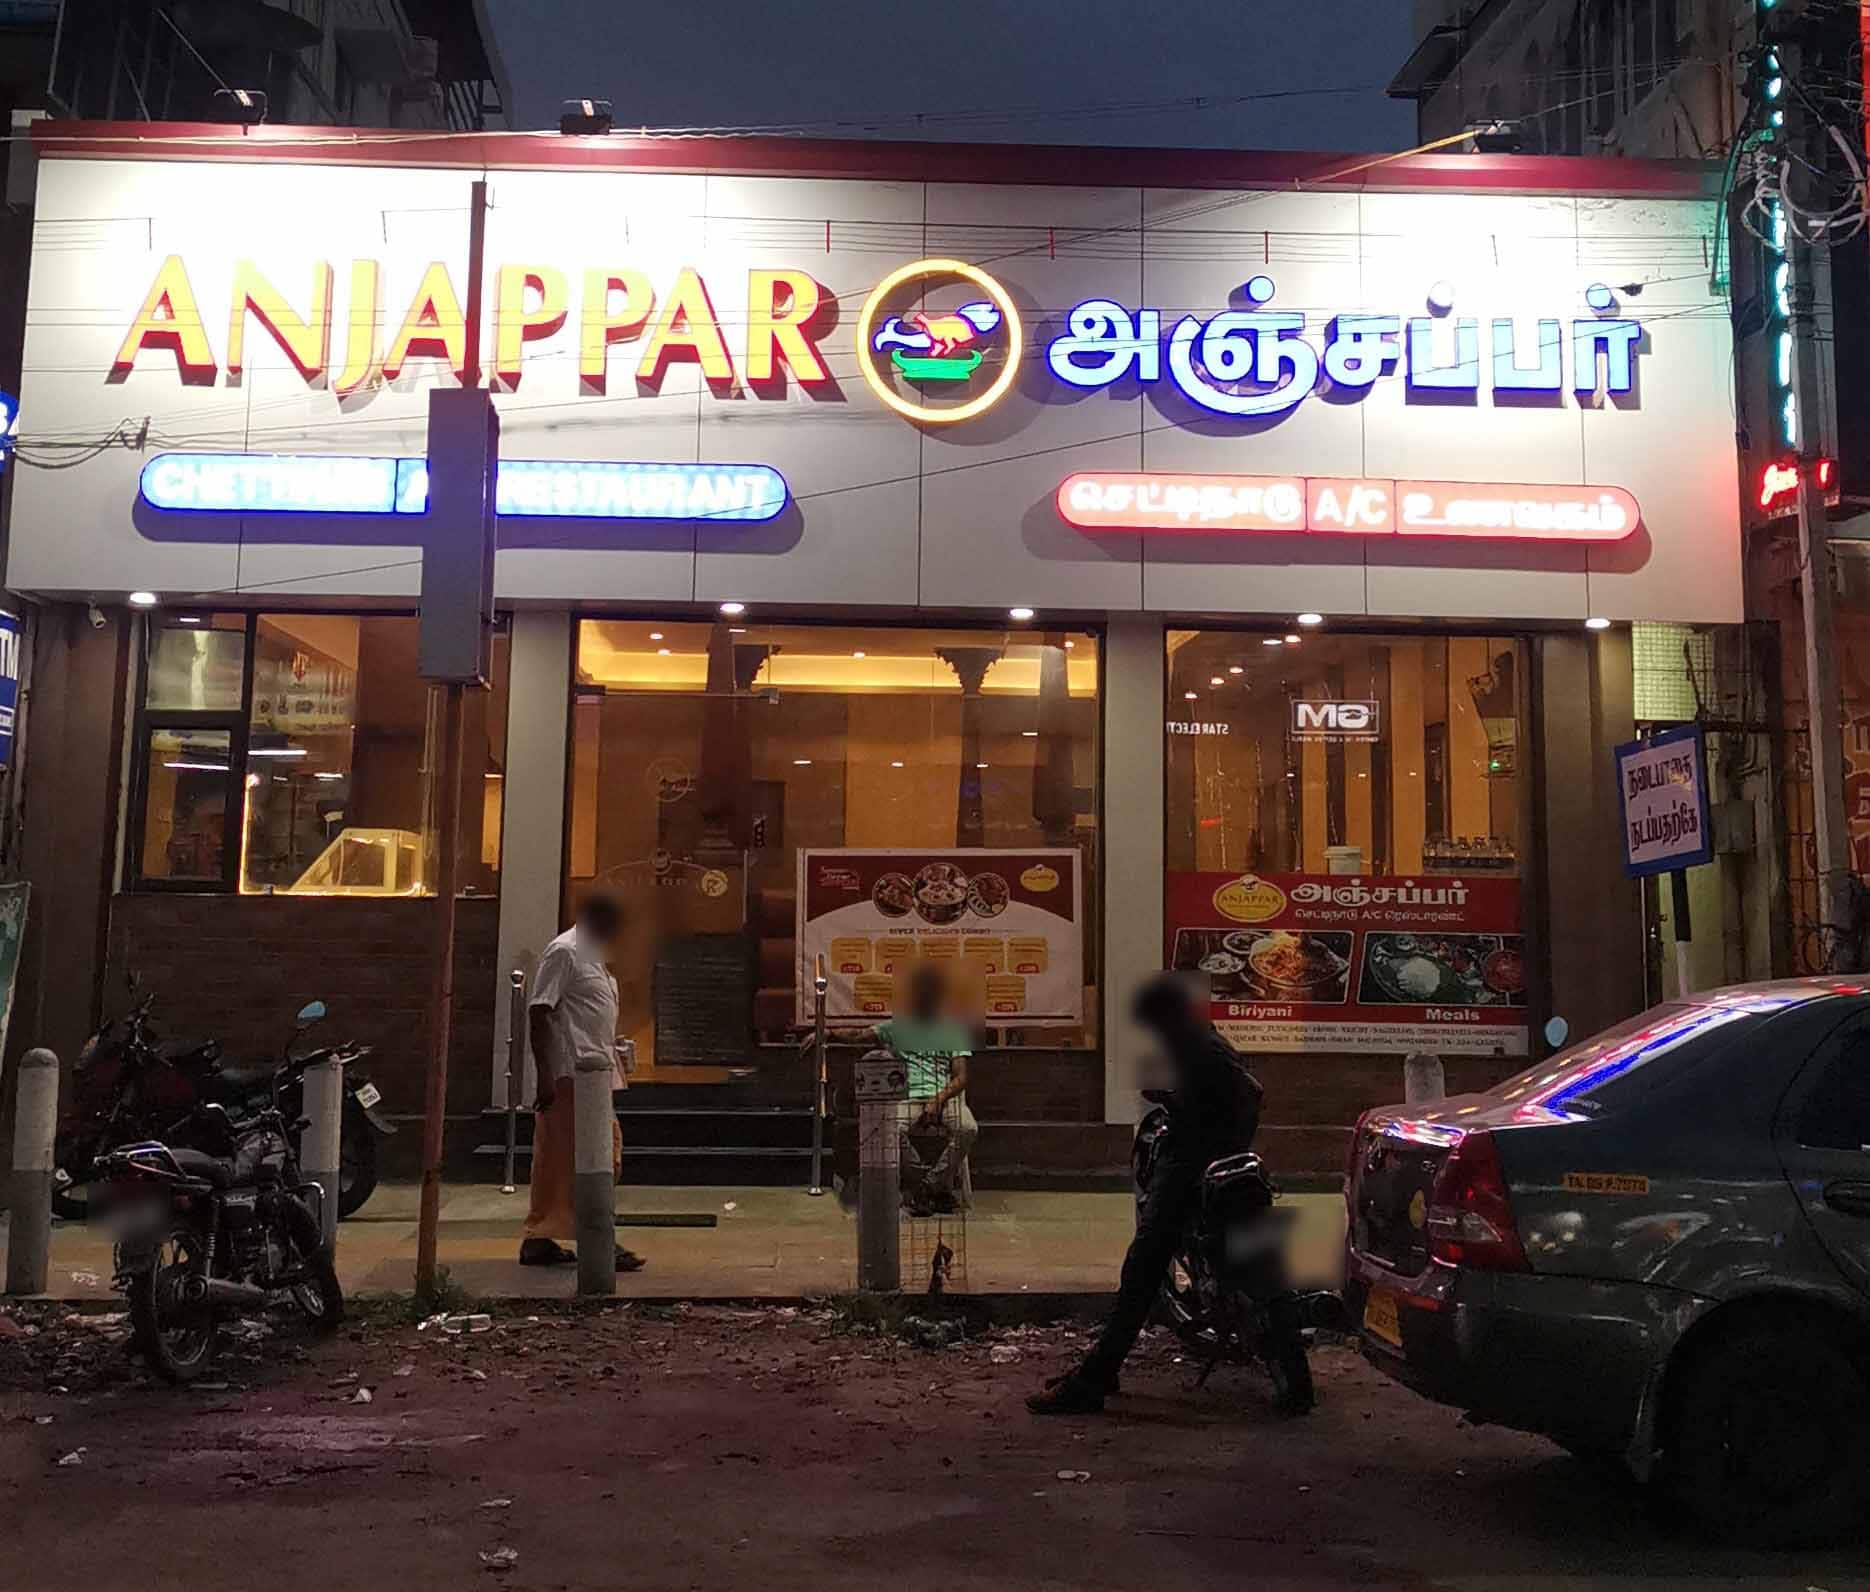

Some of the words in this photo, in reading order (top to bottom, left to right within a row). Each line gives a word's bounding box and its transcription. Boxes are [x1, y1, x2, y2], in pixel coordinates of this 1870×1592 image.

[106, 253, 842, 403] ANJAPPAR
[1047, 276, 1643, 416] அஞ்சப்பர்
[151, 461, 389, 505] CHETT
[1314, 487, 1387, 526] A/C
[1290, 878, 1470, 907] அஞ்சப்பர்
[1228, 1004, 1293, 1019] Biriyani
[1425, 1007, 1481, 1022] Meals
